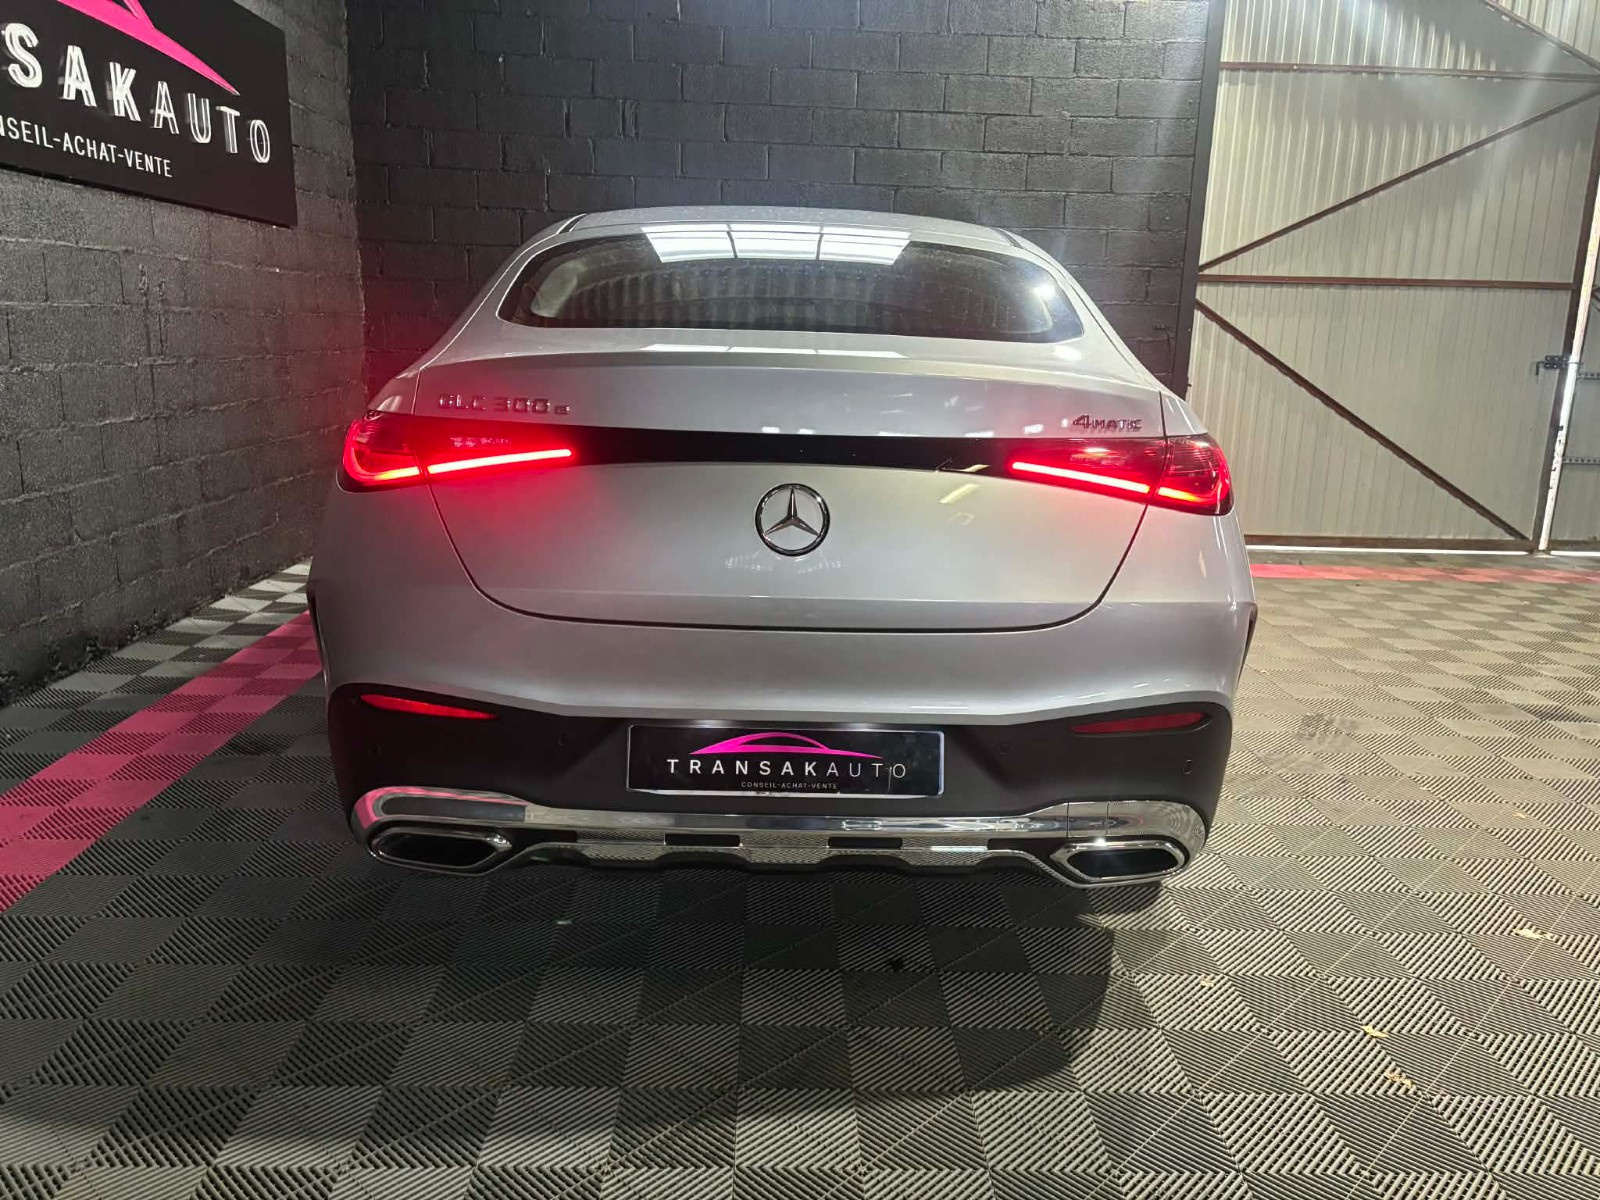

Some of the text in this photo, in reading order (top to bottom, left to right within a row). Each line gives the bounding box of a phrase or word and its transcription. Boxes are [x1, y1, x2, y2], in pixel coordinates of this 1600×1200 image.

[437, 393, 487, 411] GLC
[494, 396, 551, 414] 300
[1072, 413, 1143, 431] 4MATIC
[666, 758, 907, 779] TRANSAKAUTO
[740, 780, 838, 790] CONSEIL-ACHAT-VENTE
